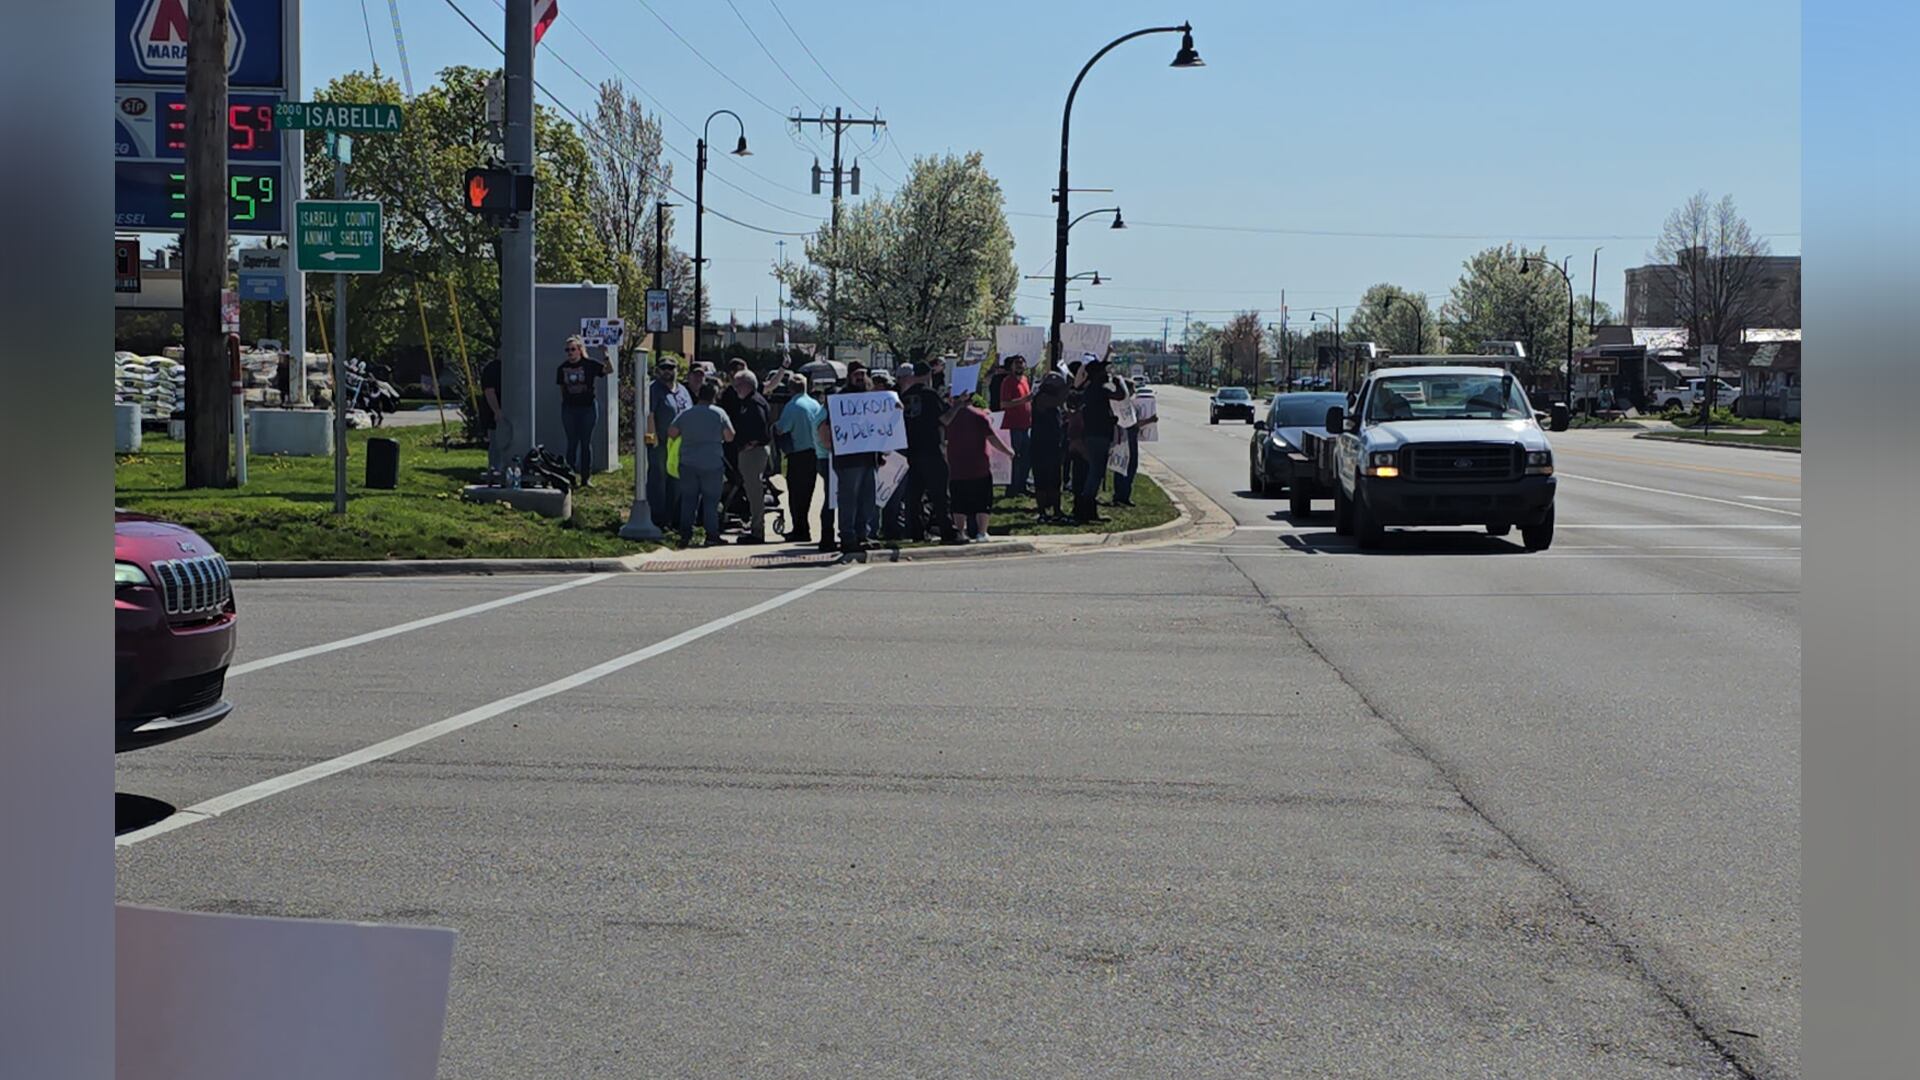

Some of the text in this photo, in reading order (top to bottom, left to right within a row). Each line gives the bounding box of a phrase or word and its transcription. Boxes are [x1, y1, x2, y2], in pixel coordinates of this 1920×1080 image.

[147, 44, 188, 59] MARA
[124, 99, 145, 113] STP
[276, 104, 302, 115] 2000
[286, 116, 293, 127] S
[305, 106, 398, 129] ISABELLA
[300, 211, 375, 227] ISABELLA COUNTY
[303, 230, 374, 247] ANIMAL SHELTER
[840, 397, 895, 416] LOCKOUT
